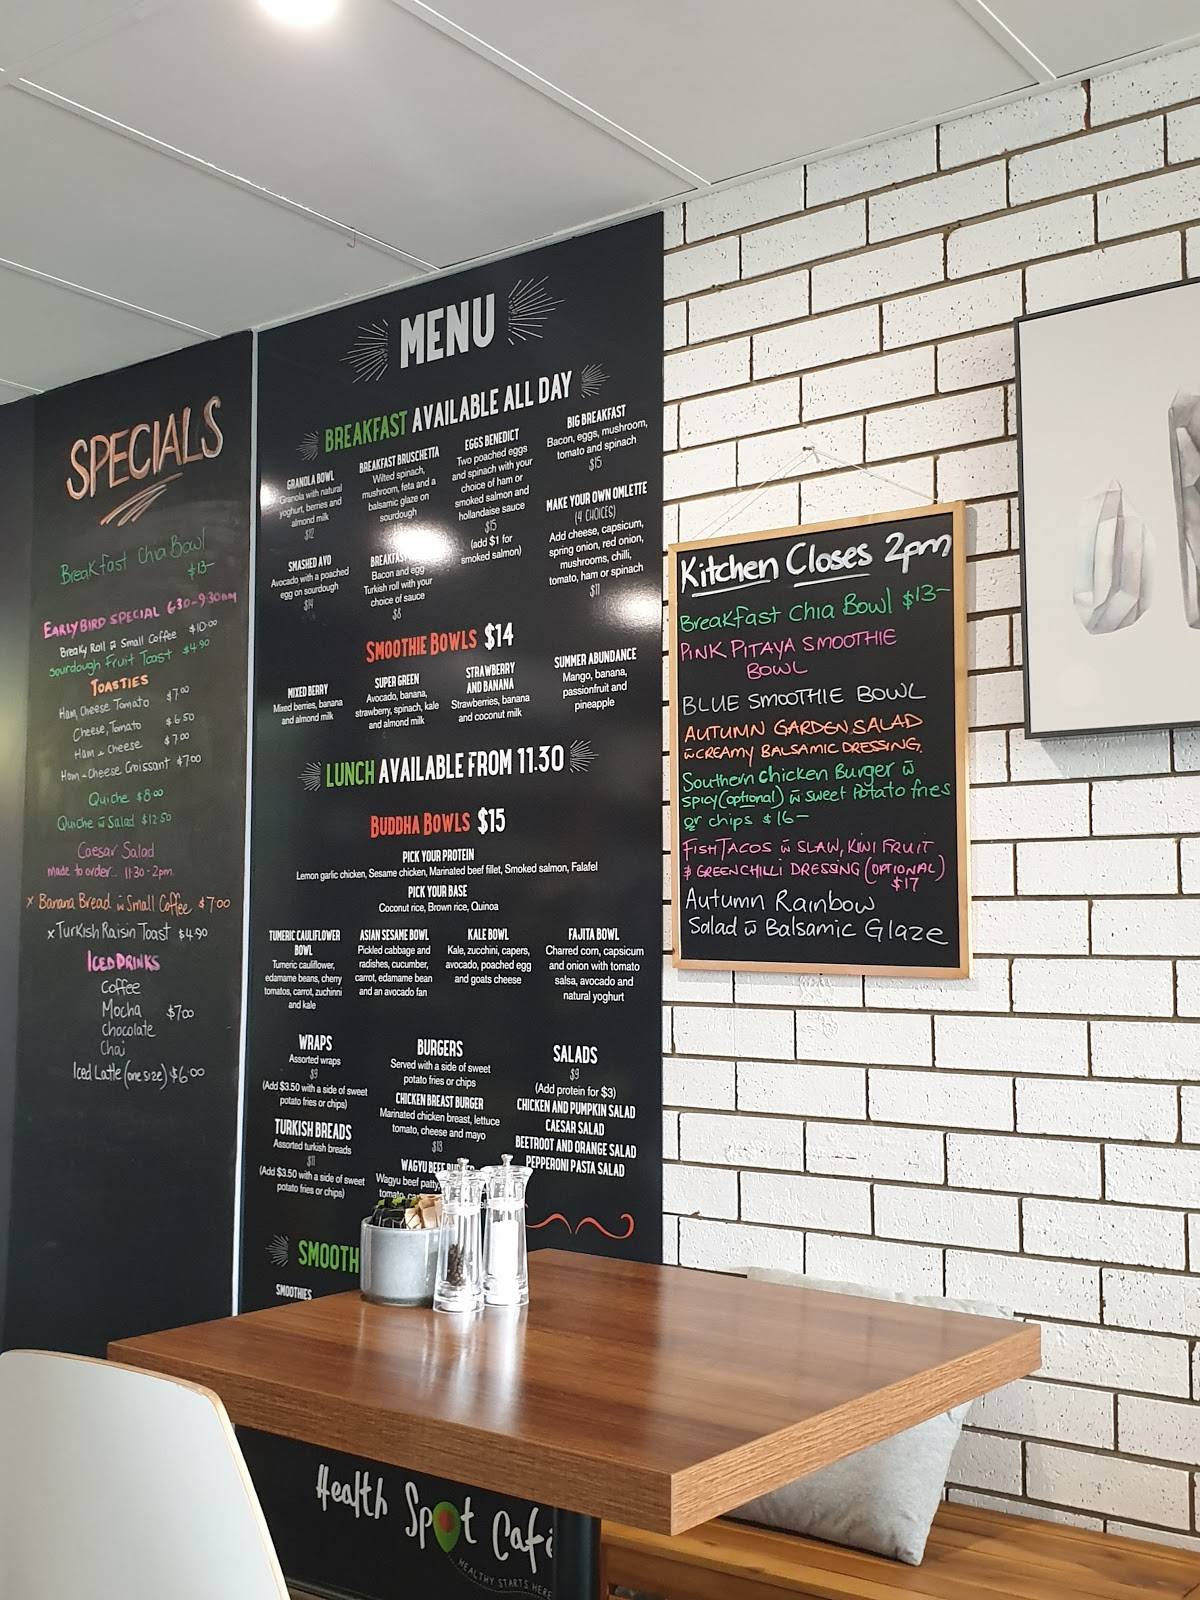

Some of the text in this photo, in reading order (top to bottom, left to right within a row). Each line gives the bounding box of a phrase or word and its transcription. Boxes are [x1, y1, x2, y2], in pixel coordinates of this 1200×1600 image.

[400, 293, 495, 368] MENU
[325, 370, 572, 453] BREAKFAST AVAILABLE ALL DAY
[567, 404, 626, 429] BIG BREAKFAST
[465, 428, 519, 450] EGGS BENEDICT
[547, 418, 648, 449] Bacon, eggs, mushroom,
[66, 396, 223, 500] SPECIALS
[359, 446, 440, 473] BREAKFAST BRUSCHETTA
[286, 470, 335, 490] GRANOLA BOWL
[546, 481, 648, 512] MAKE YOUR OWN OMLETTE
[681, 532, 951, 593] Kitchen Closes 2pm
[789, 602, 834, 621] Chia
[843, 587, 893, 615] Bowl
[110, 607, 160, 624] SPECIAL
[484, 622, 514, 650] $14
[803, 629, 897, 652] SMOOTHIE
[105, 653, 135, 669] Fruit
[139, 649, 174, 666] Toast
[554, 648, 637, 669] SUMMER ABUNDANCE
[747, 661, 808, 679] BOWL
[90, 674, 149, 697] TOASTIES
[288, 684, 329, 699] MIXED BERRY
[374, 673, 420, 689] SUPER GREEN
[683, 683, 926, 716] BLUE SMOOTHIE BOWL
[684, 713, 923, 743] AUTUMN GARDEN SALAD
[761, 743, 839, 758] BALSAMIC
[326, 745, 565, 788] LUNCH AVAILABLE FROM 11.30
[682, 772, 755, 792] Southern
[835, 760, 896, 787] Burger
[89, 792, 130, 807] Quiche
[477, 807, 506, 835] $15
[708, 813, 753, 831] chips
[78, 841, 155, 860] Caesar Salad
[403, 848, 474, 863] PICK YOUR PROTEIN
[790, 861, 860, 876] DRESSING
[408, 884, 467, 898] PICK YOUR BASE
[891, 877, 919, 892] $17
[38, 891, 192, 916] Banana Bread Small Coffee
[379, 901, 499, 915] Coconut rice, Brown rice, Quinoa
[685, 887, 875, 914] Autumn Rainbow
[102, 922, 136, 939] Raisin
[137, 922, 172, 941] Toast
[468, 928, 509, 941] KALE BOWL
[568, 928, 620, 941] FAJITA BOWL
[688, 916, 949, 945] Salad Balsamic Glaze
[101, 978, 142, 996] Coffee
[102, 998, 143, 1019] Mocha
[100, 1040, 126, 1057] Chai
[299, 1034, 333, 1051] WRAPS
[417, 1038, 464, 1058] BURGERS
[553, 1044, 598, 1065] SALADS
[73, 1061, 92, 1081] Iced
[274, 1118, 352, 1140] TURKISH BREADS
[545, 1119, 605, 1136] CAESAR SALAD
[526, 1155, 625, 1177] PEPPERONI PASTA SALAD
[276, 1284, 312, 1301] SMOOTHIES
[316, 1464, 388, 1519] Health
[459, 1558, 494, 1586] HEALTHY
[498, 1578, 529, 1591] STARTS
